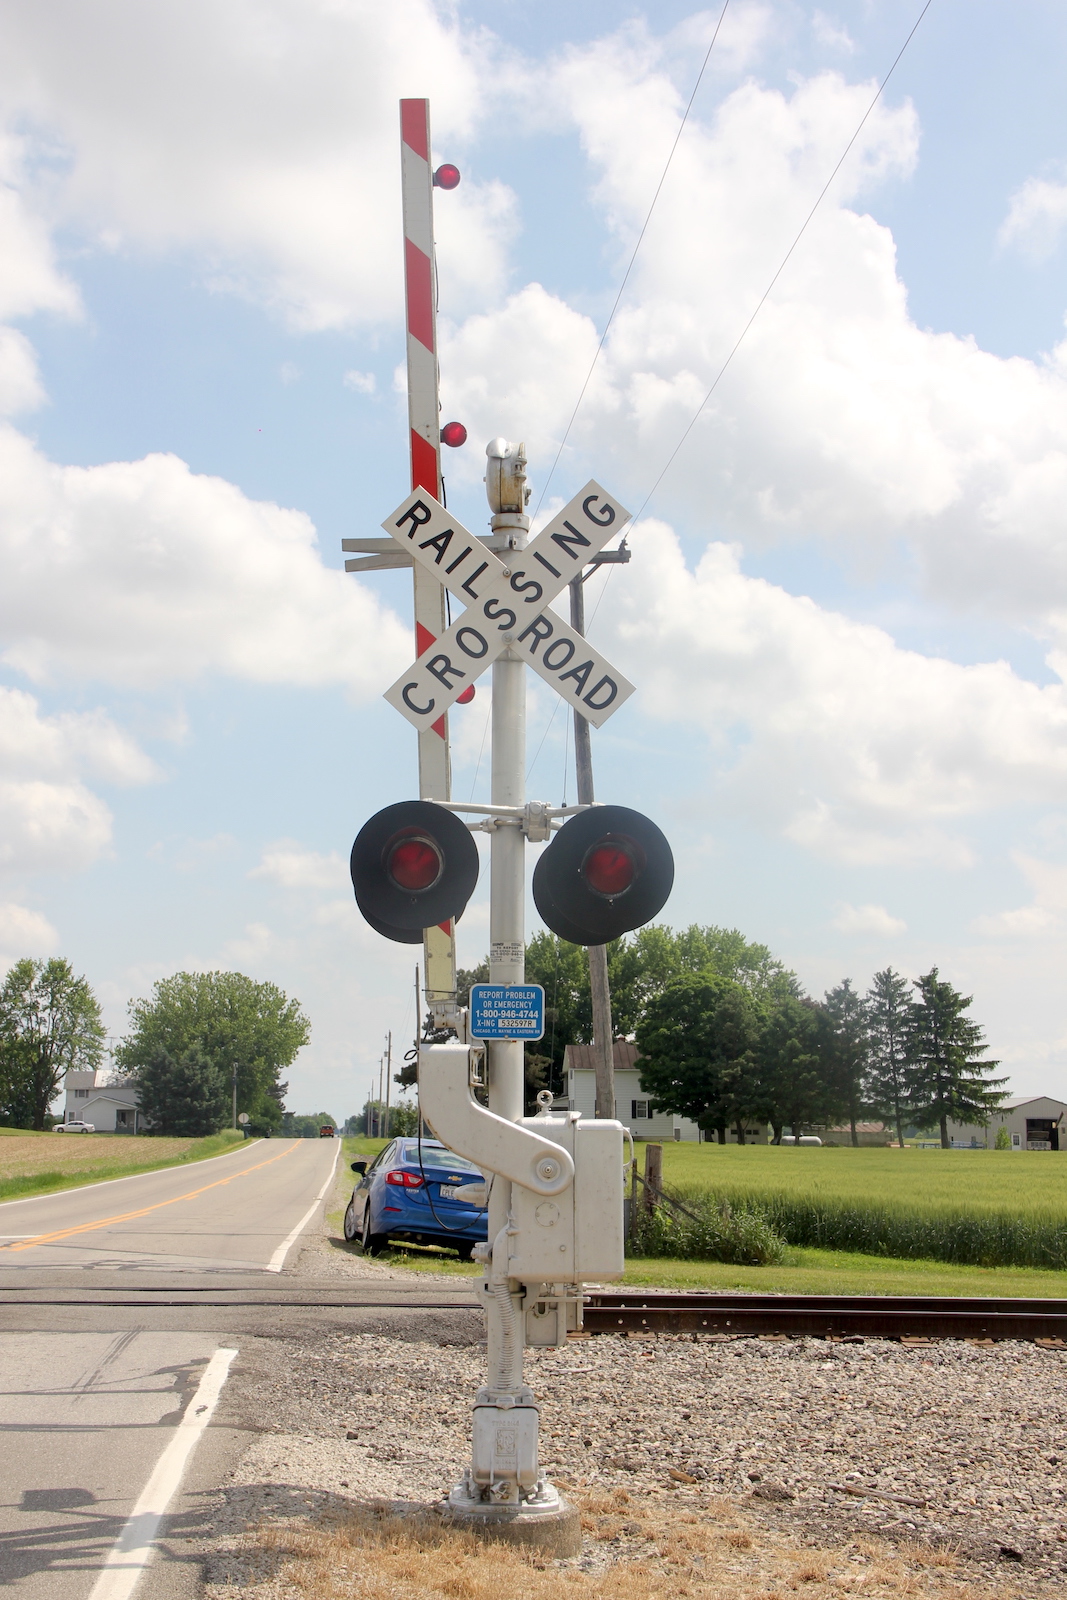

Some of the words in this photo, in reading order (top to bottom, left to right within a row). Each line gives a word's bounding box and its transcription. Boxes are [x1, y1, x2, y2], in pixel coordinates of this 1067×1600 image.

[401, 495, 616, 715] CROSSING
[479, 990, 503, 999] REPORT
[505, 991, 536, 999] PROBLEM
[483, 1000, 492, 1008] OR
[494, 1000, 533, 1009] EMERGENCY
[475, 1009, 539, 1018] 1-800-946-4744
[477, 1019, 496, 1027] X-ING
[501, 1019, 533, 1027] 532597R
